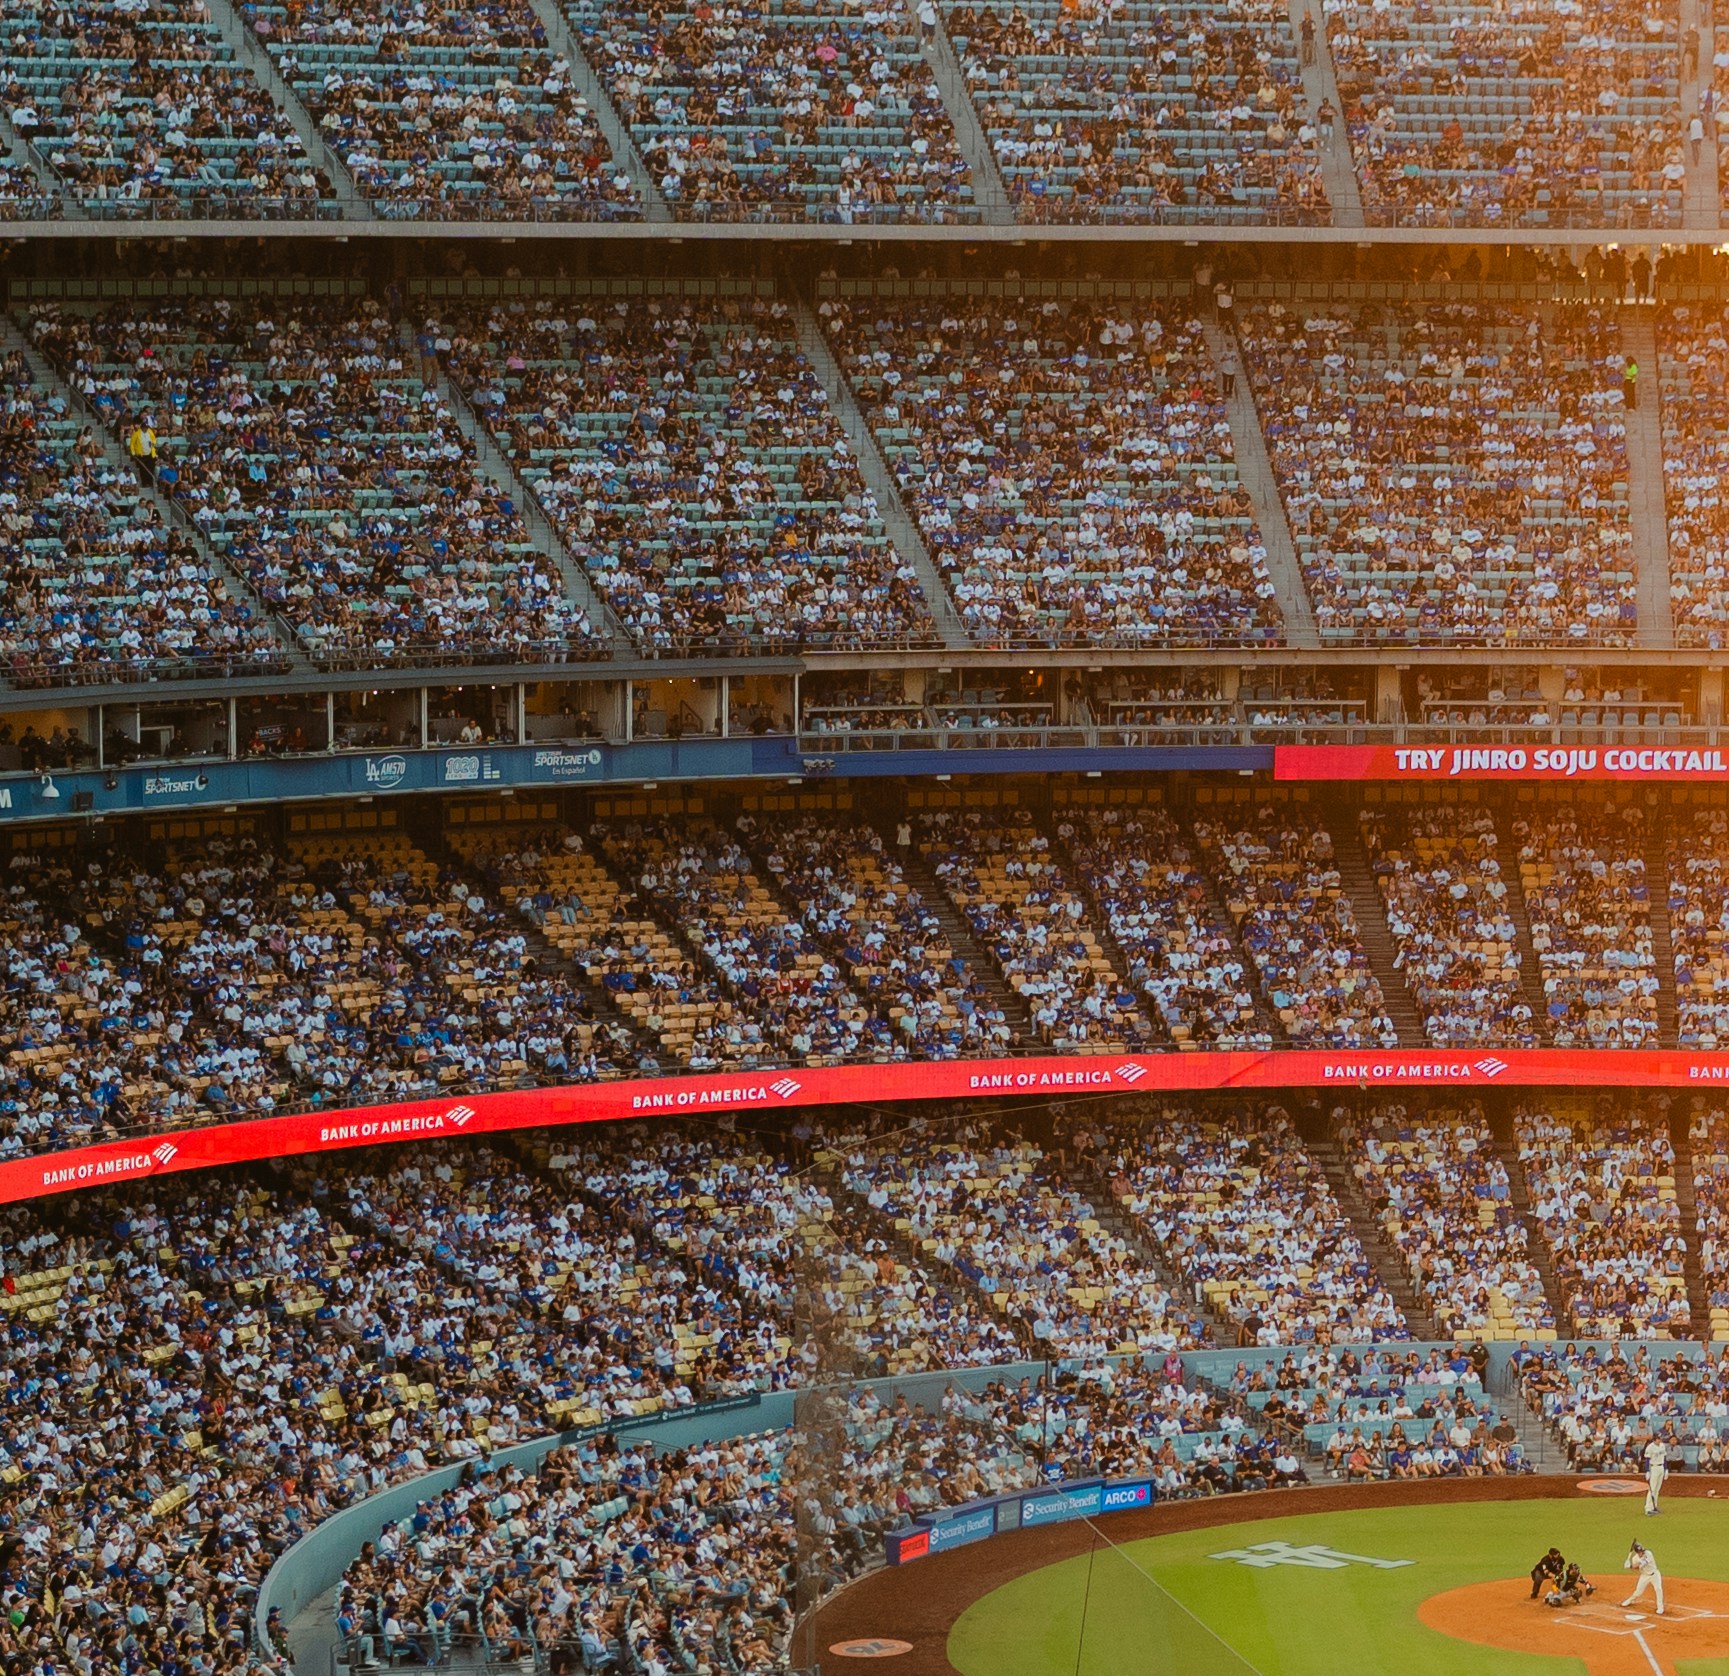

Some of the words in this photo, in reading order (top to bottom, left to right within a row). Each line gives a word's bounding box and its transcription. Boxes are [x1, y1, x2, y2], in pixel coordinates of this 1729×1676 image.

[366, 758, 380, 781] LA
[446, 756, 479, 774] 1020
[534, 754, 588, 766] SPORTSNET
[1394, 750, 1445, 769] TRY
[1450, 750, 1526, 775] JINRO
[1533, 749, 1597, 775] SOJU
[1604, 751, 1727, 771] COCKTAIL
[145, 781, 195, 794] SPORTSNET
[970, 1074, 1012, 1088] BANK
[1017, 1073, 1037, 1085] OF
[1040, 1071, 1111, 1084] AMERICA
[1324, 1065, 1368, 1077] BANK
[1373, 1065, 1393, 1077] OF
[1397, 1064, 1470, 1077] AMERICA
[633, 1094, 673, 1108] BANK
[677, 1092, 696, 1104] OF
[699, 1087, 767, 1103] AMERICA
[321, 1125, 357, 1141] BANK
[362, 1123, 378, 1135] OF
[381, 1116, 443, 1133] AMERICA
[43, 1168, 75, 1184] BANK
[78, 1164, 93, 1178] OF
[96, 1155, 151, 1175] AMERICA
[1035, 1499, 1068, 1515] Security
[1069, 1494, 1098, 1508] Benefit
[1105, 1490, 1136, 1504] ARCO
[940, 1524, 966, 1540] Security
[967, 1515, 991, 1534] Benefit
